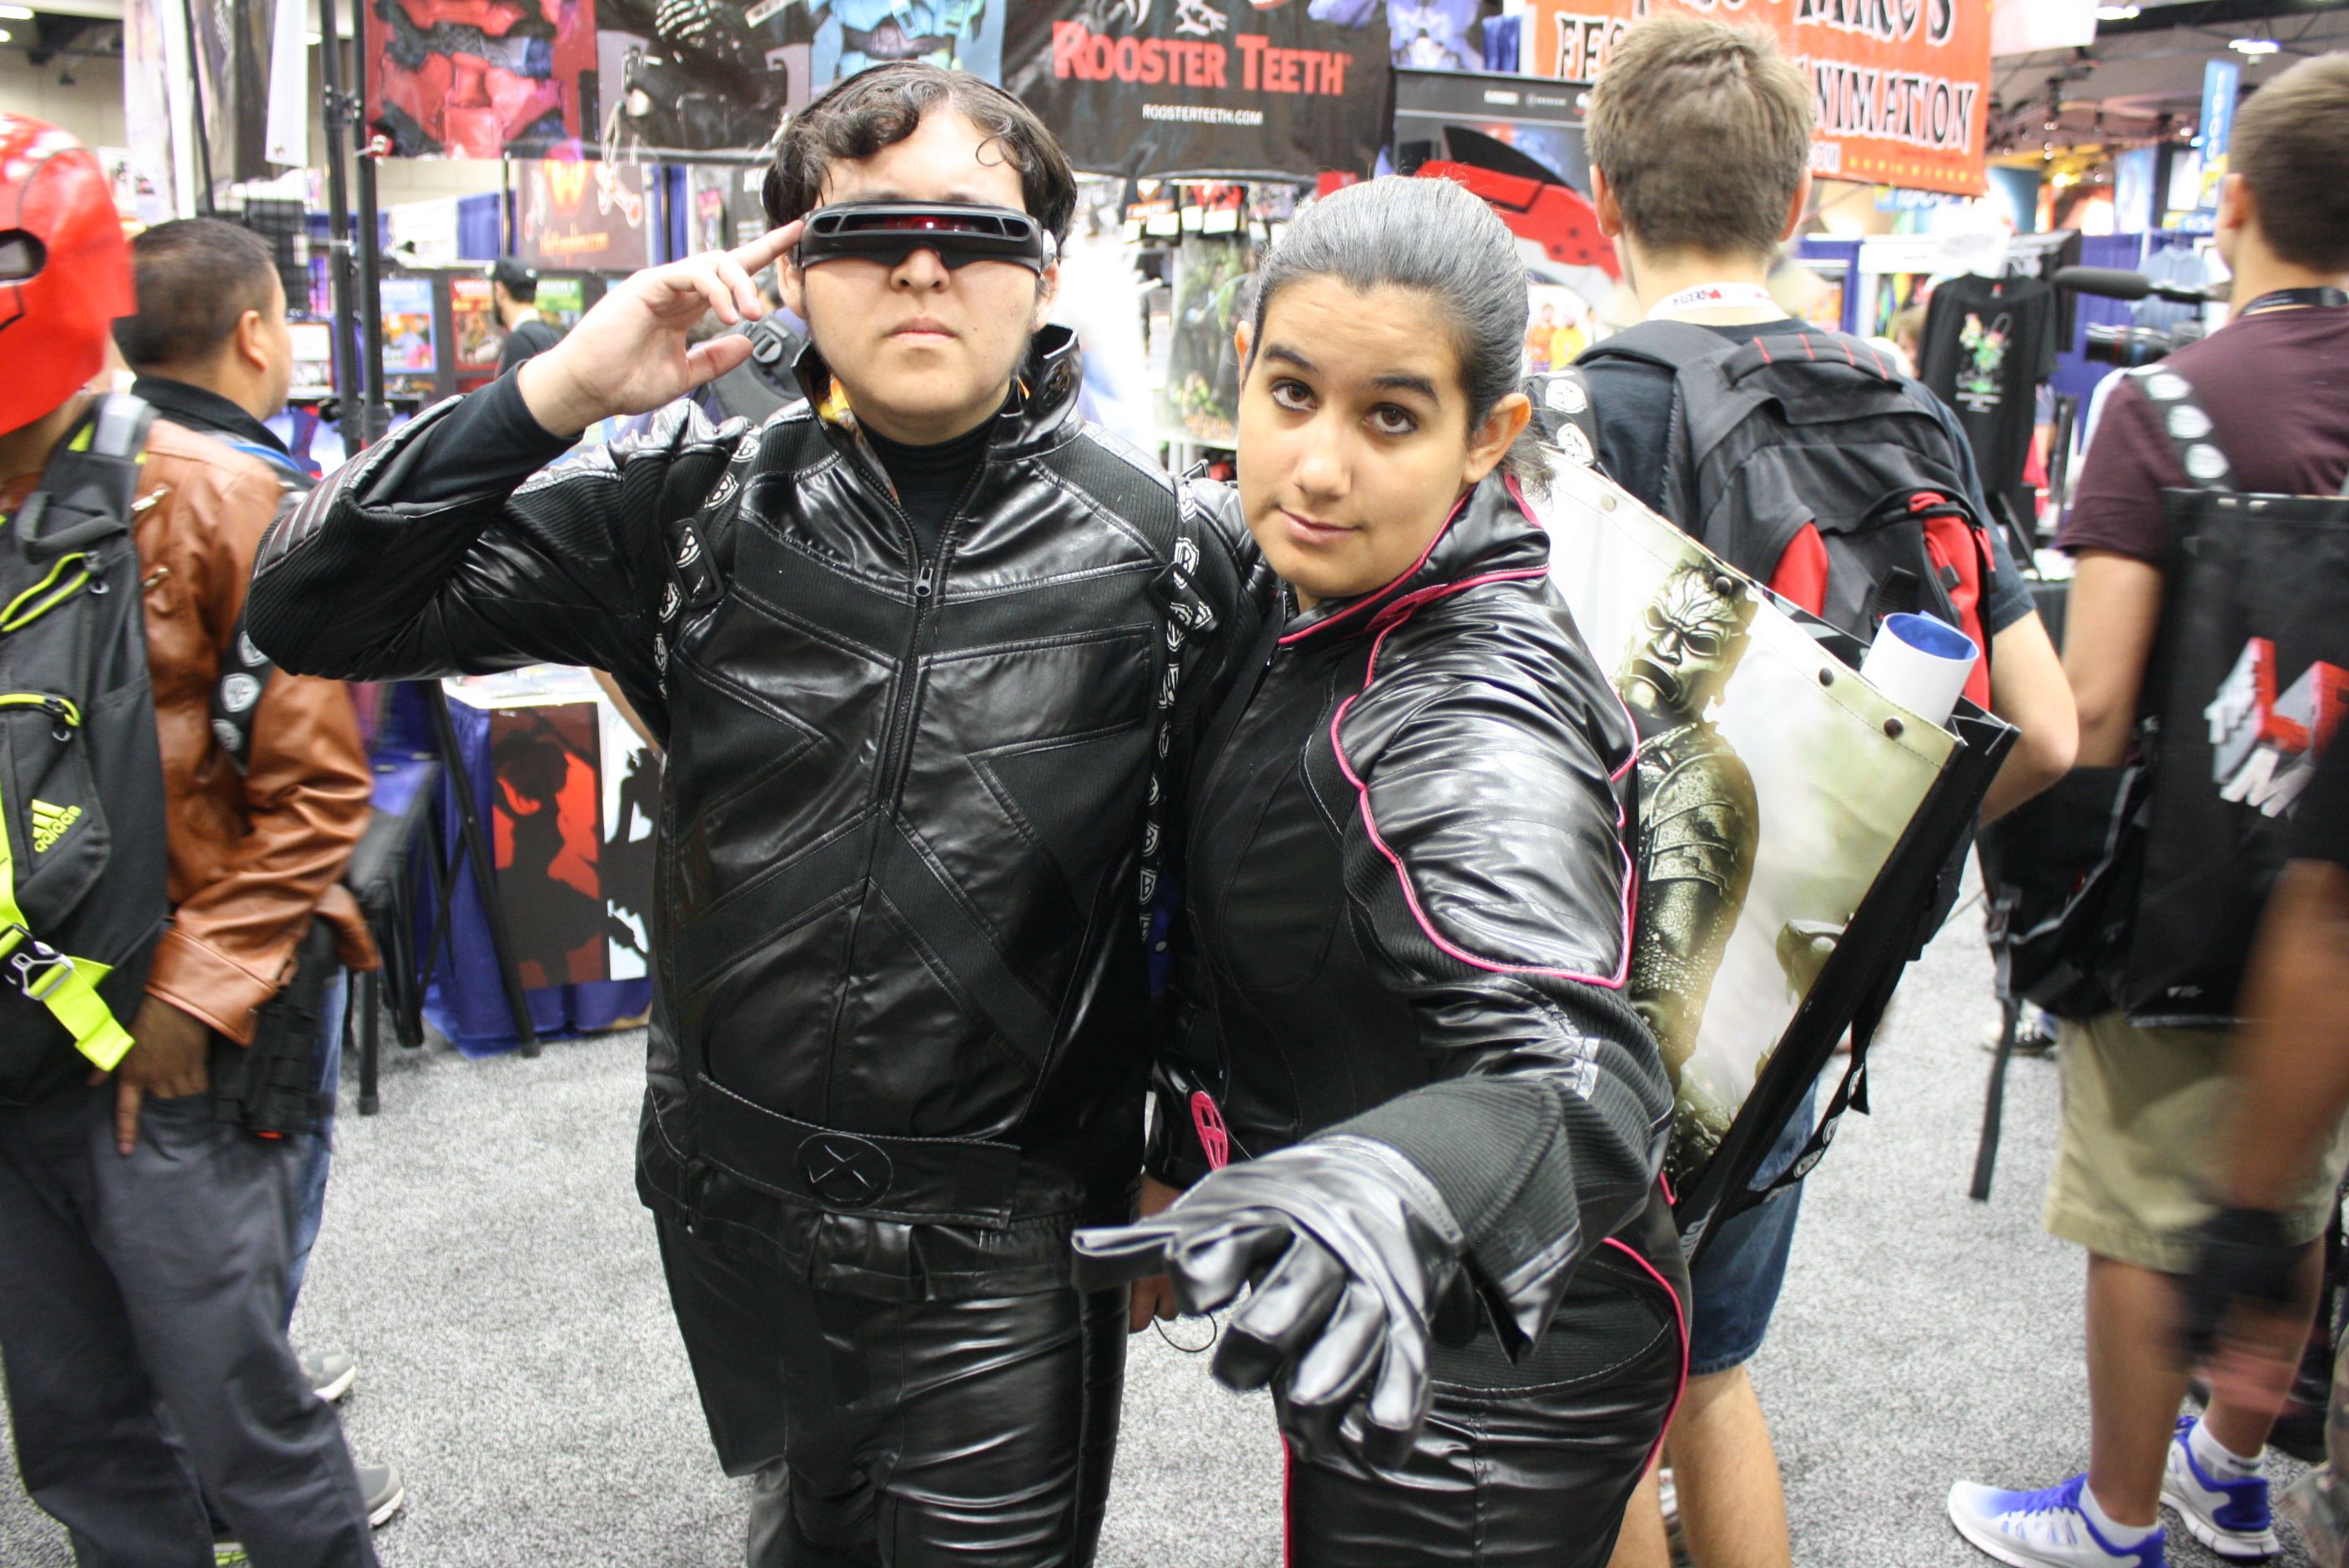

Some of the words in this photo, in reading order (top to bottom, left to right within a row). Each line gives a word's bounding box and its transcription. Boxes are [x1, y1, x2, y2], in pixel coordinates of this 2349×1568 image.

[1053, 21, 1227, 88] ROOSTER
[1235, 33, 1346, 96] TEETH
[1142, 103, 1264, 126] ROOSTERTEETH.COM
[1793, 54, 1980, 156] NIMATION
[33, 805, 82, 853] adidas
